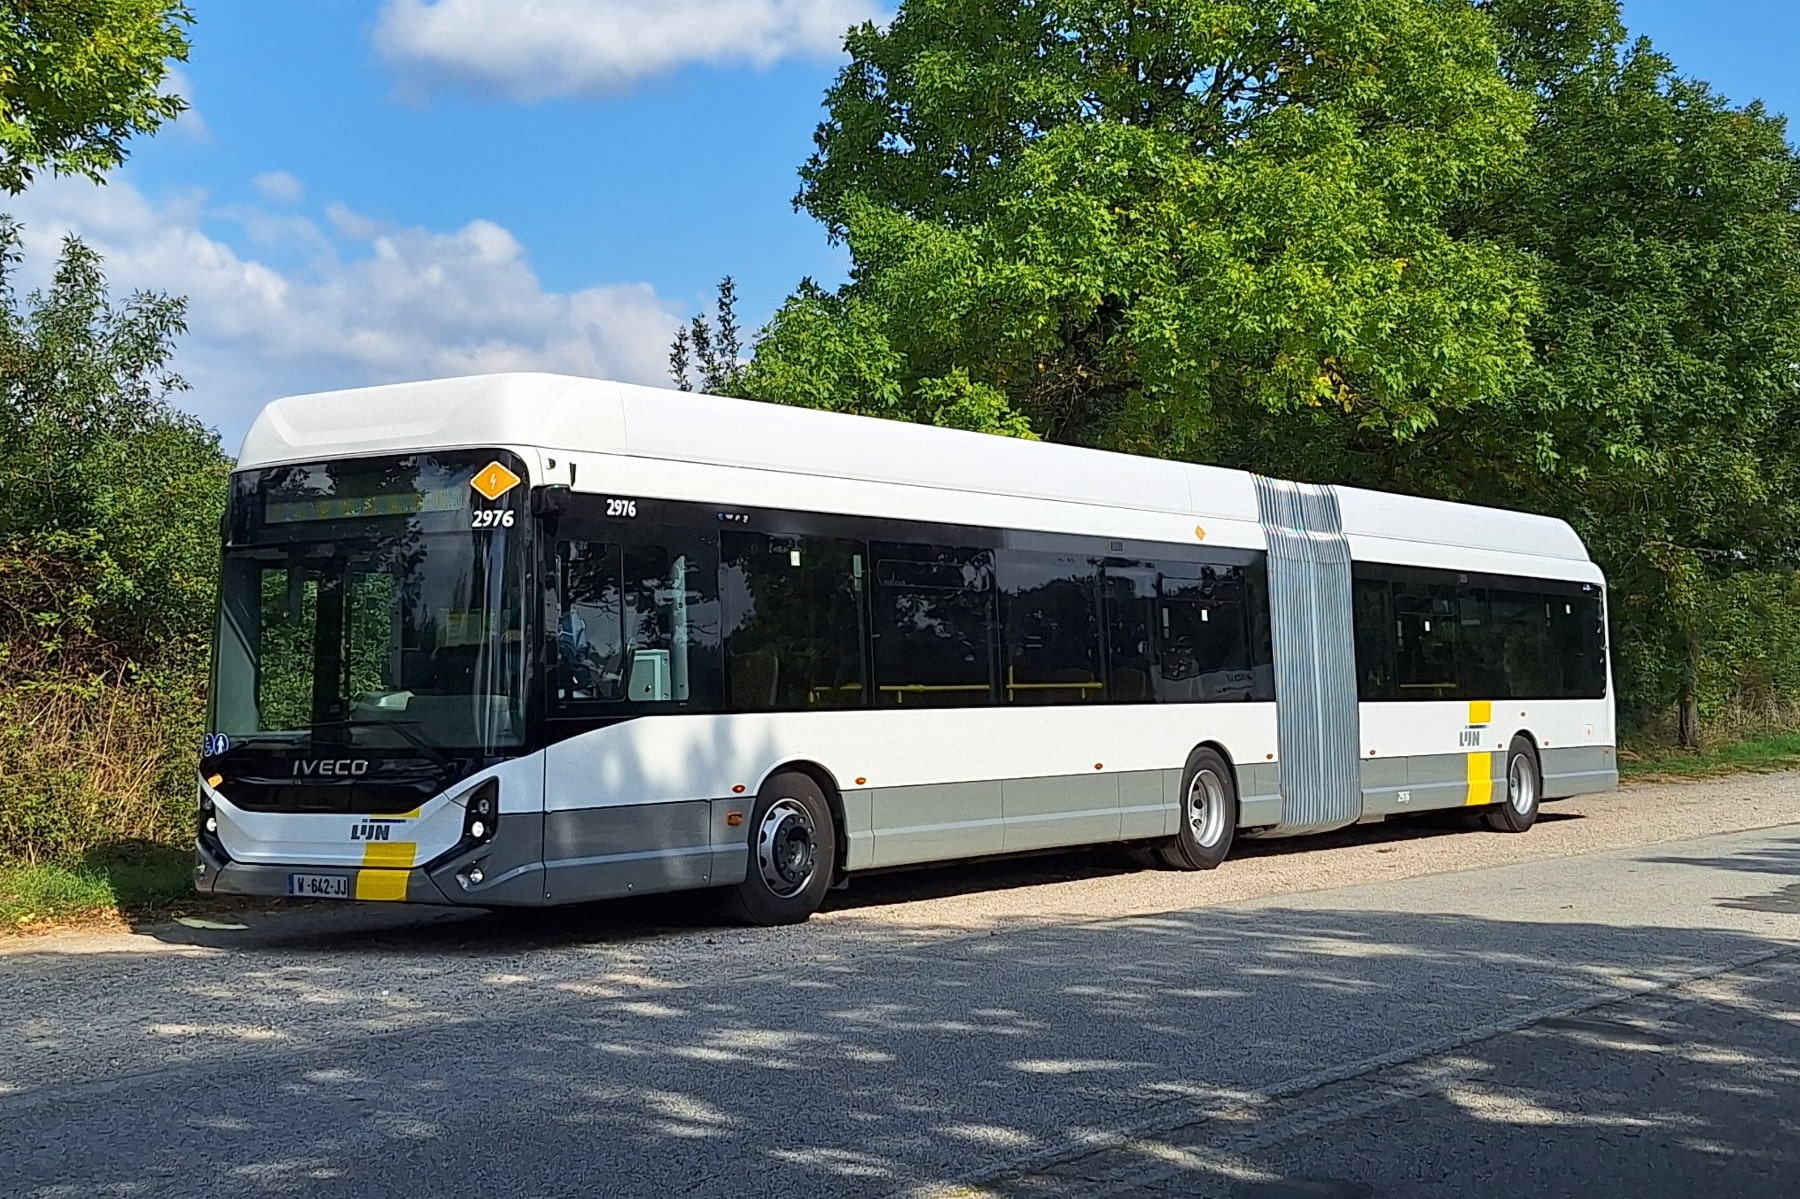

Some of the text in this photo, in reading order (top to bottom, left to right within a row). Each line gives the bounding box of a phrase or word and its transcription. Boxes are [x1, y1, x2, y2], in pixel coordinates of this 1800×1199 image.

[605, 499, 637, 517] 2976
[472, 510, 515, 528] 2976
[293, 759, 369, 776] IVECO
